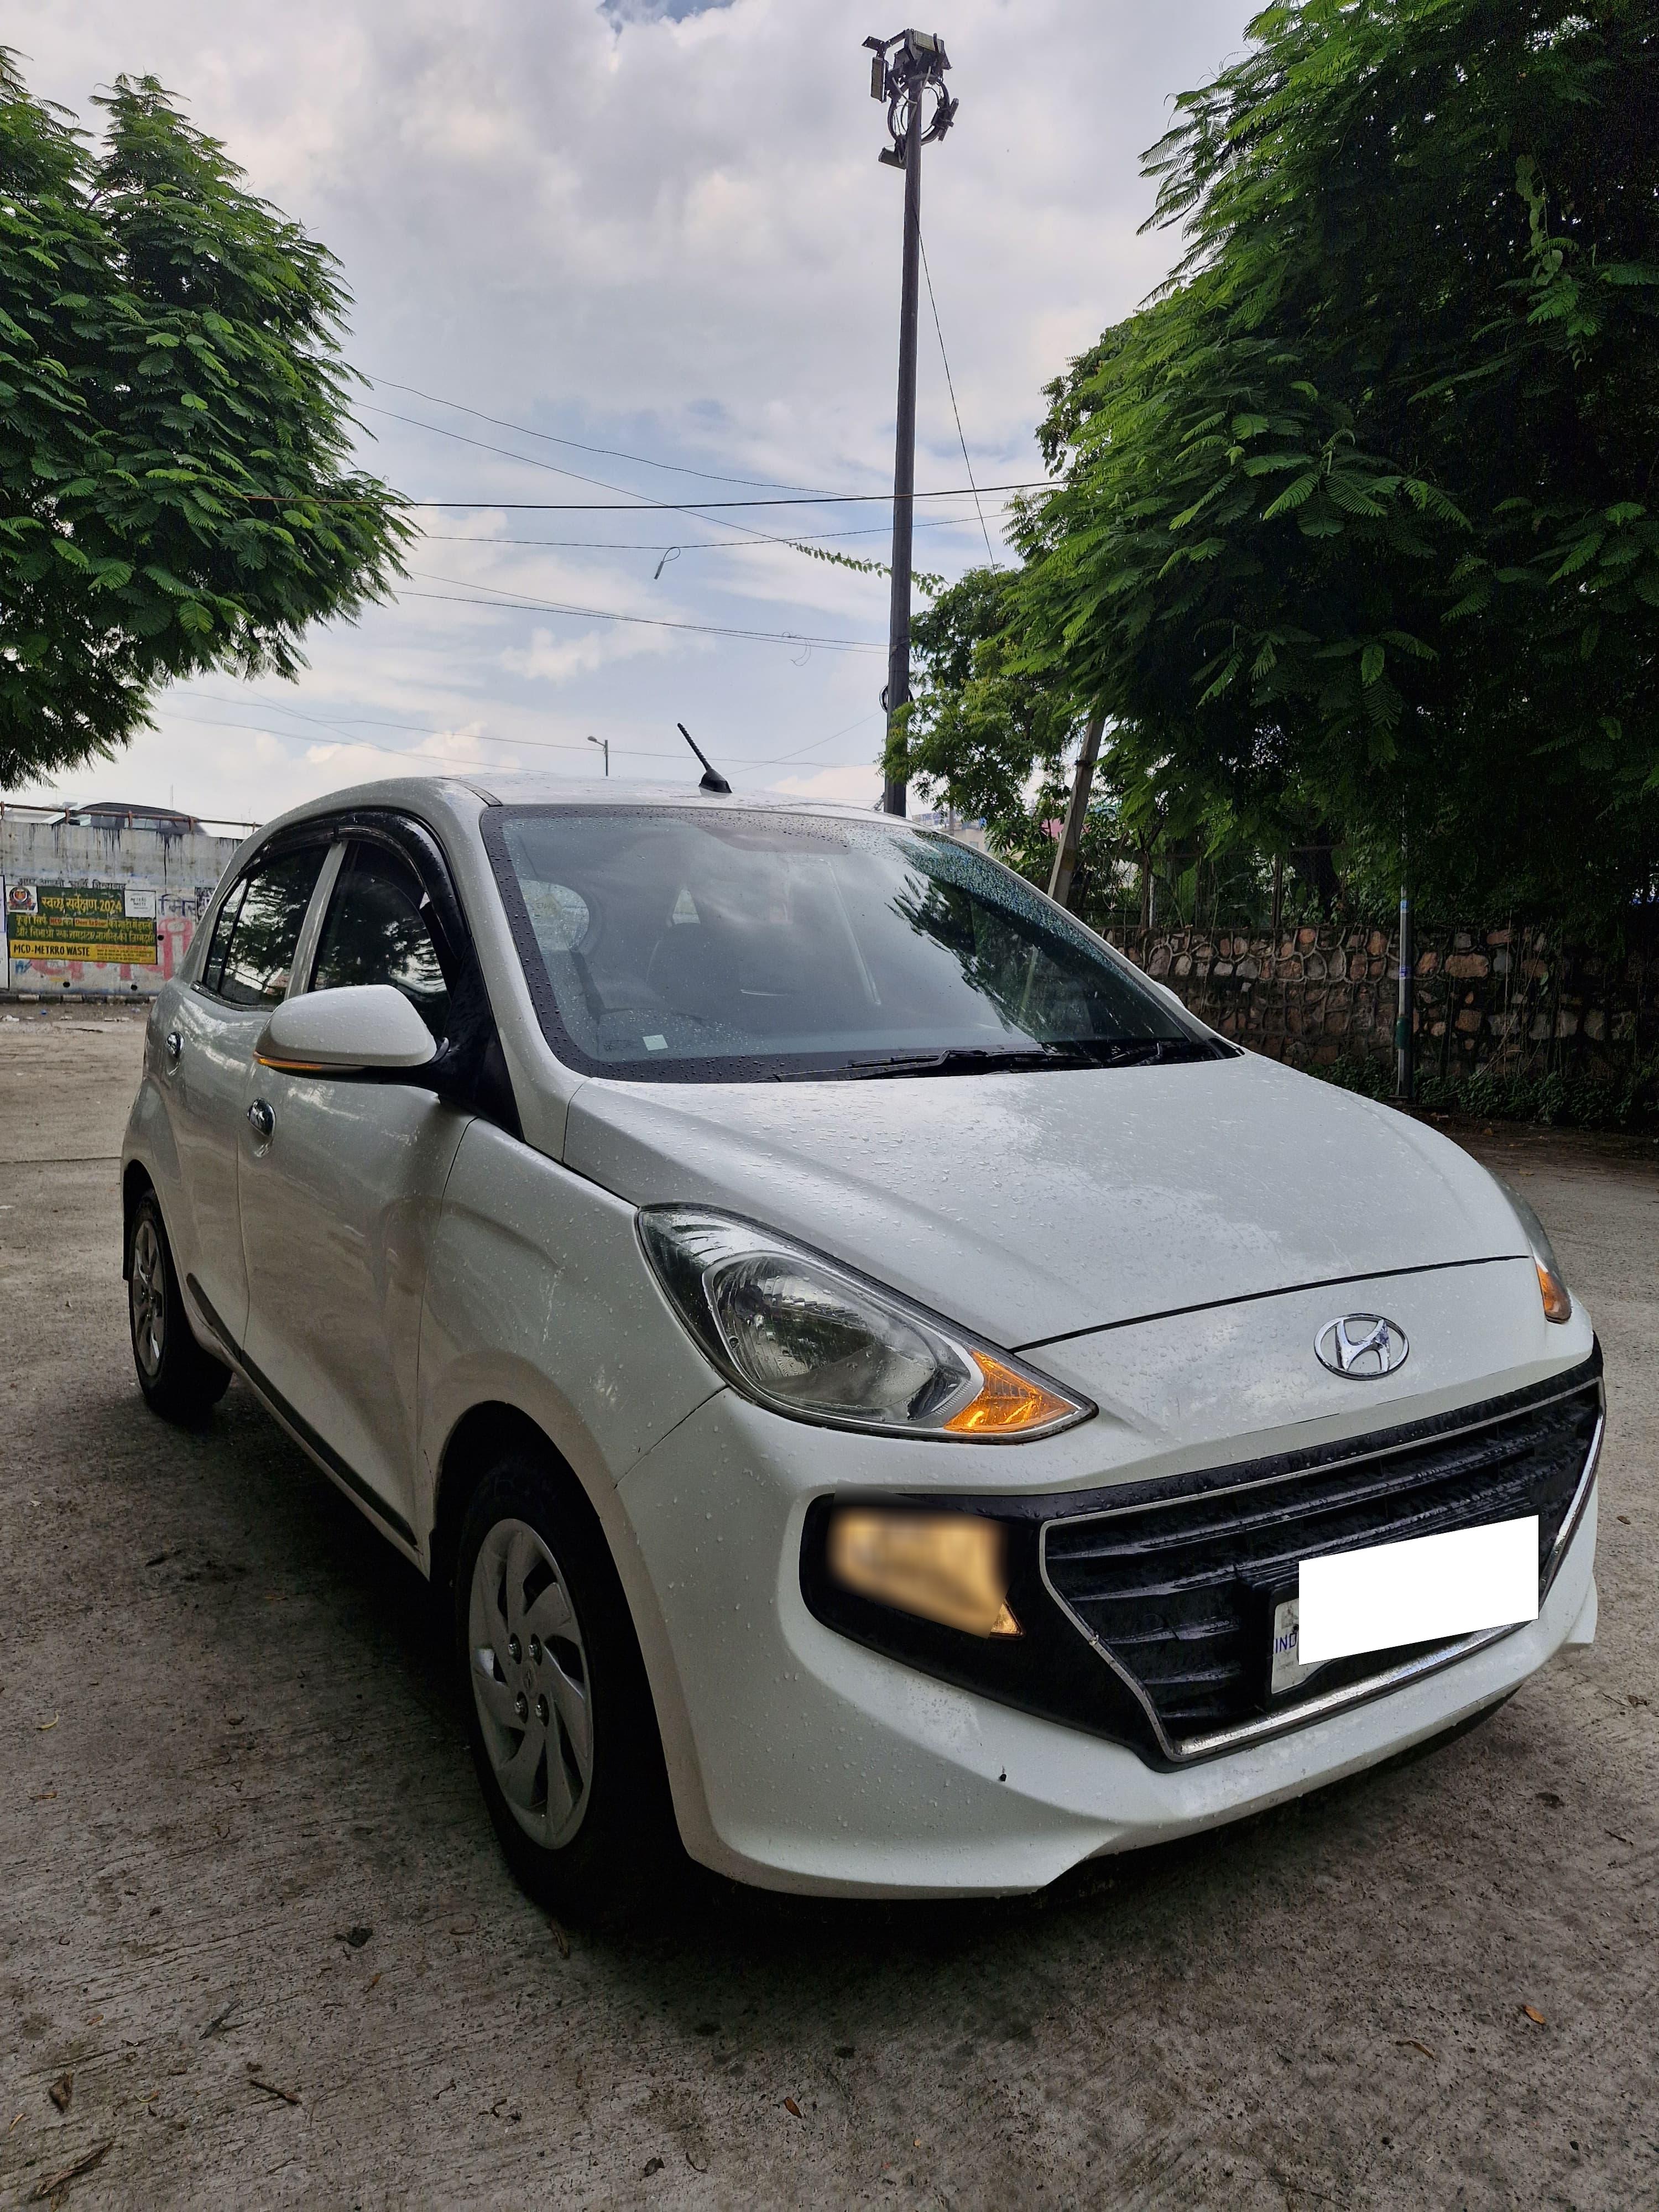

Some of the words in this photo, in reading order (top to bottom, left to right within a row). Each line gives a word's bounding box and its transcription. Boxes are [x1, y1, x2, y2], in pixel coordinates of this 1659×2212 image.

[100, 899, 122, 912] 2024
[66, 946, 90, 956] WASTE
[1275, 1633, 1297, 1653] IND
